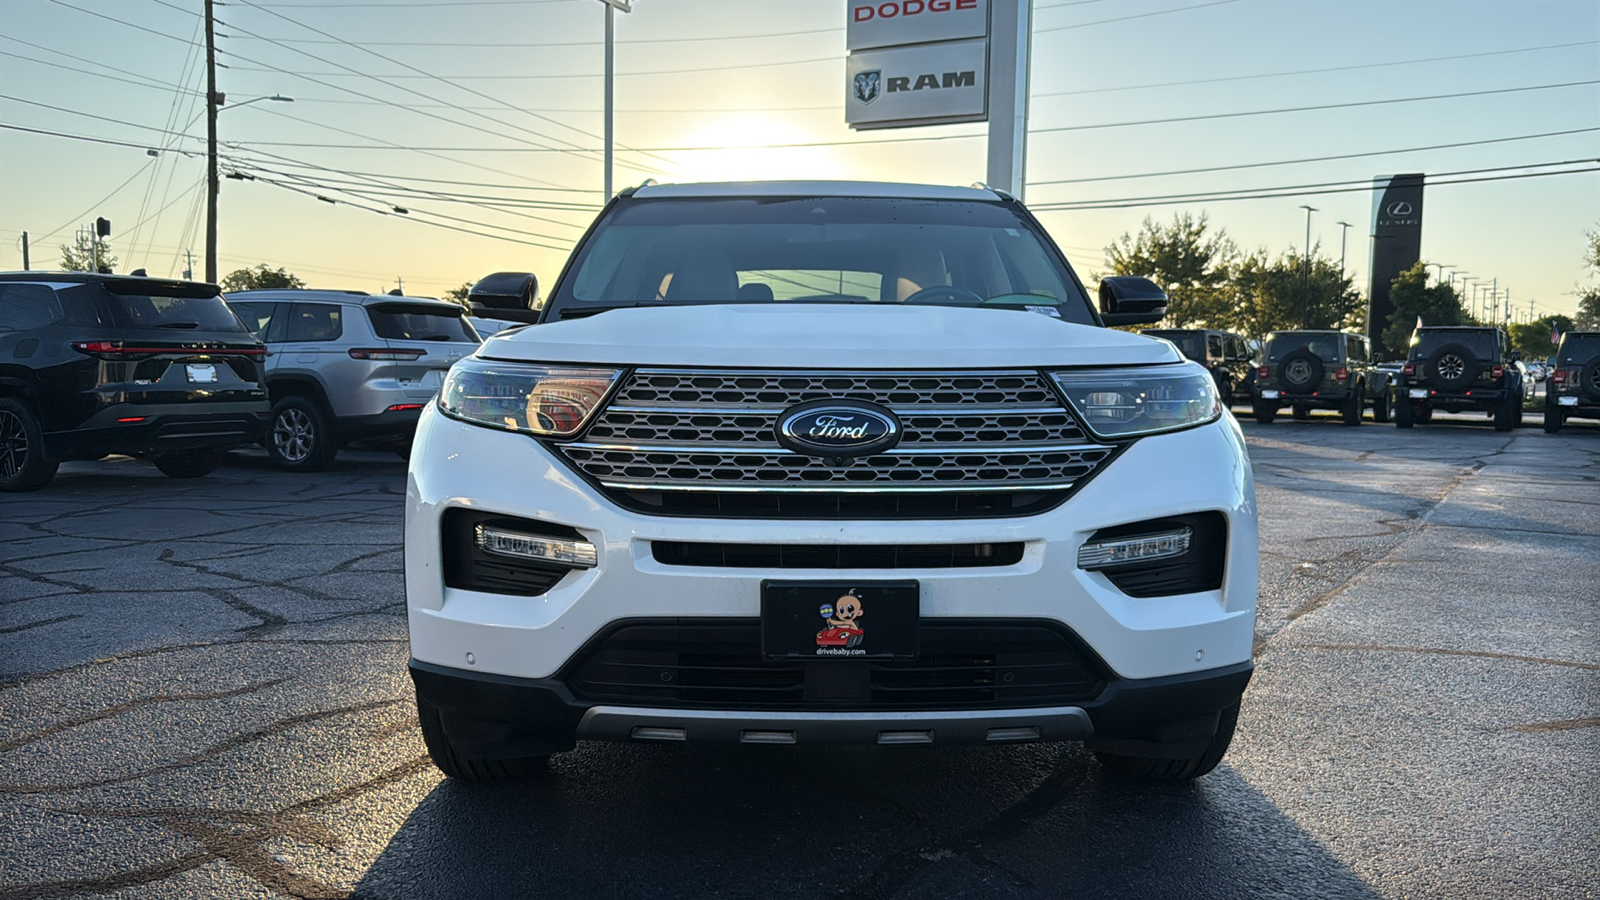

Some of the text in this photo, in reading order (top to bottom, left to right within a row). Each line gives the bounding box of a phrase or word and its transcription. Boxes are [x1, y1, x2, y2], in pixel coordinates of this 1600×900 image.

[854, 0, 977, 22] DODGE
[887, 71, 975, 93] RAM
[809, 415, 869, 439] Ford
[816, 648, 866, 656] drivebaby.com
